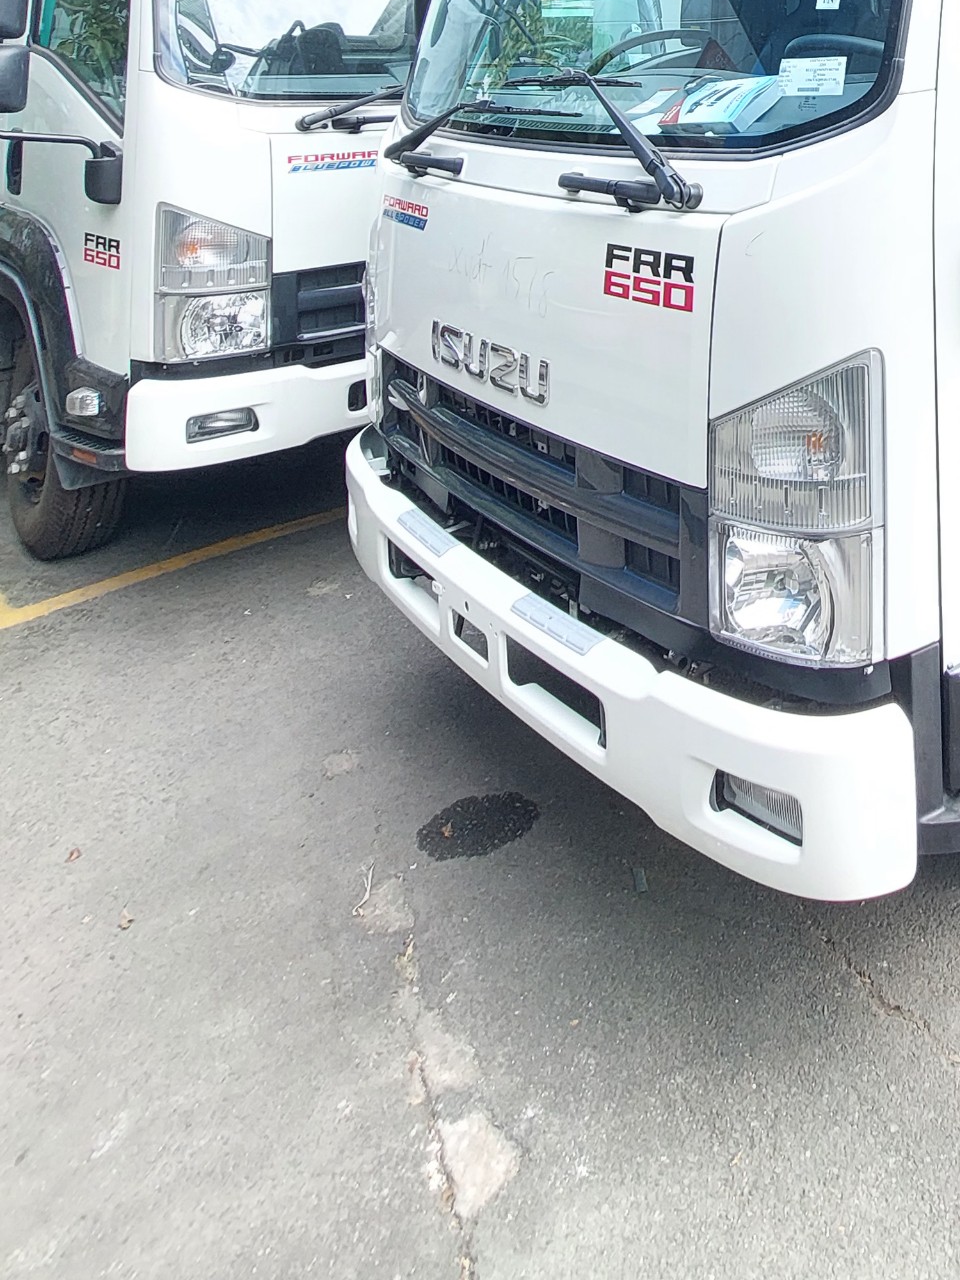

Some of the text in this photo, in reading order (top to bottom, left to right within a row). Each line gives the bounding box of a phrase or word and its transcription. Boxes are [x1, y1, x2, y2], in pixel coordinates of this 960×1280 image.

[384, 194, 429, 218] FORWARD
[84, 232, 120, 255] FRR
[84, 247, 120, 270] 650
[605, 243, 695, 284] FRR
[603, 269, 694, 313] 650
[431, 318, 551, 408] ISUZU
